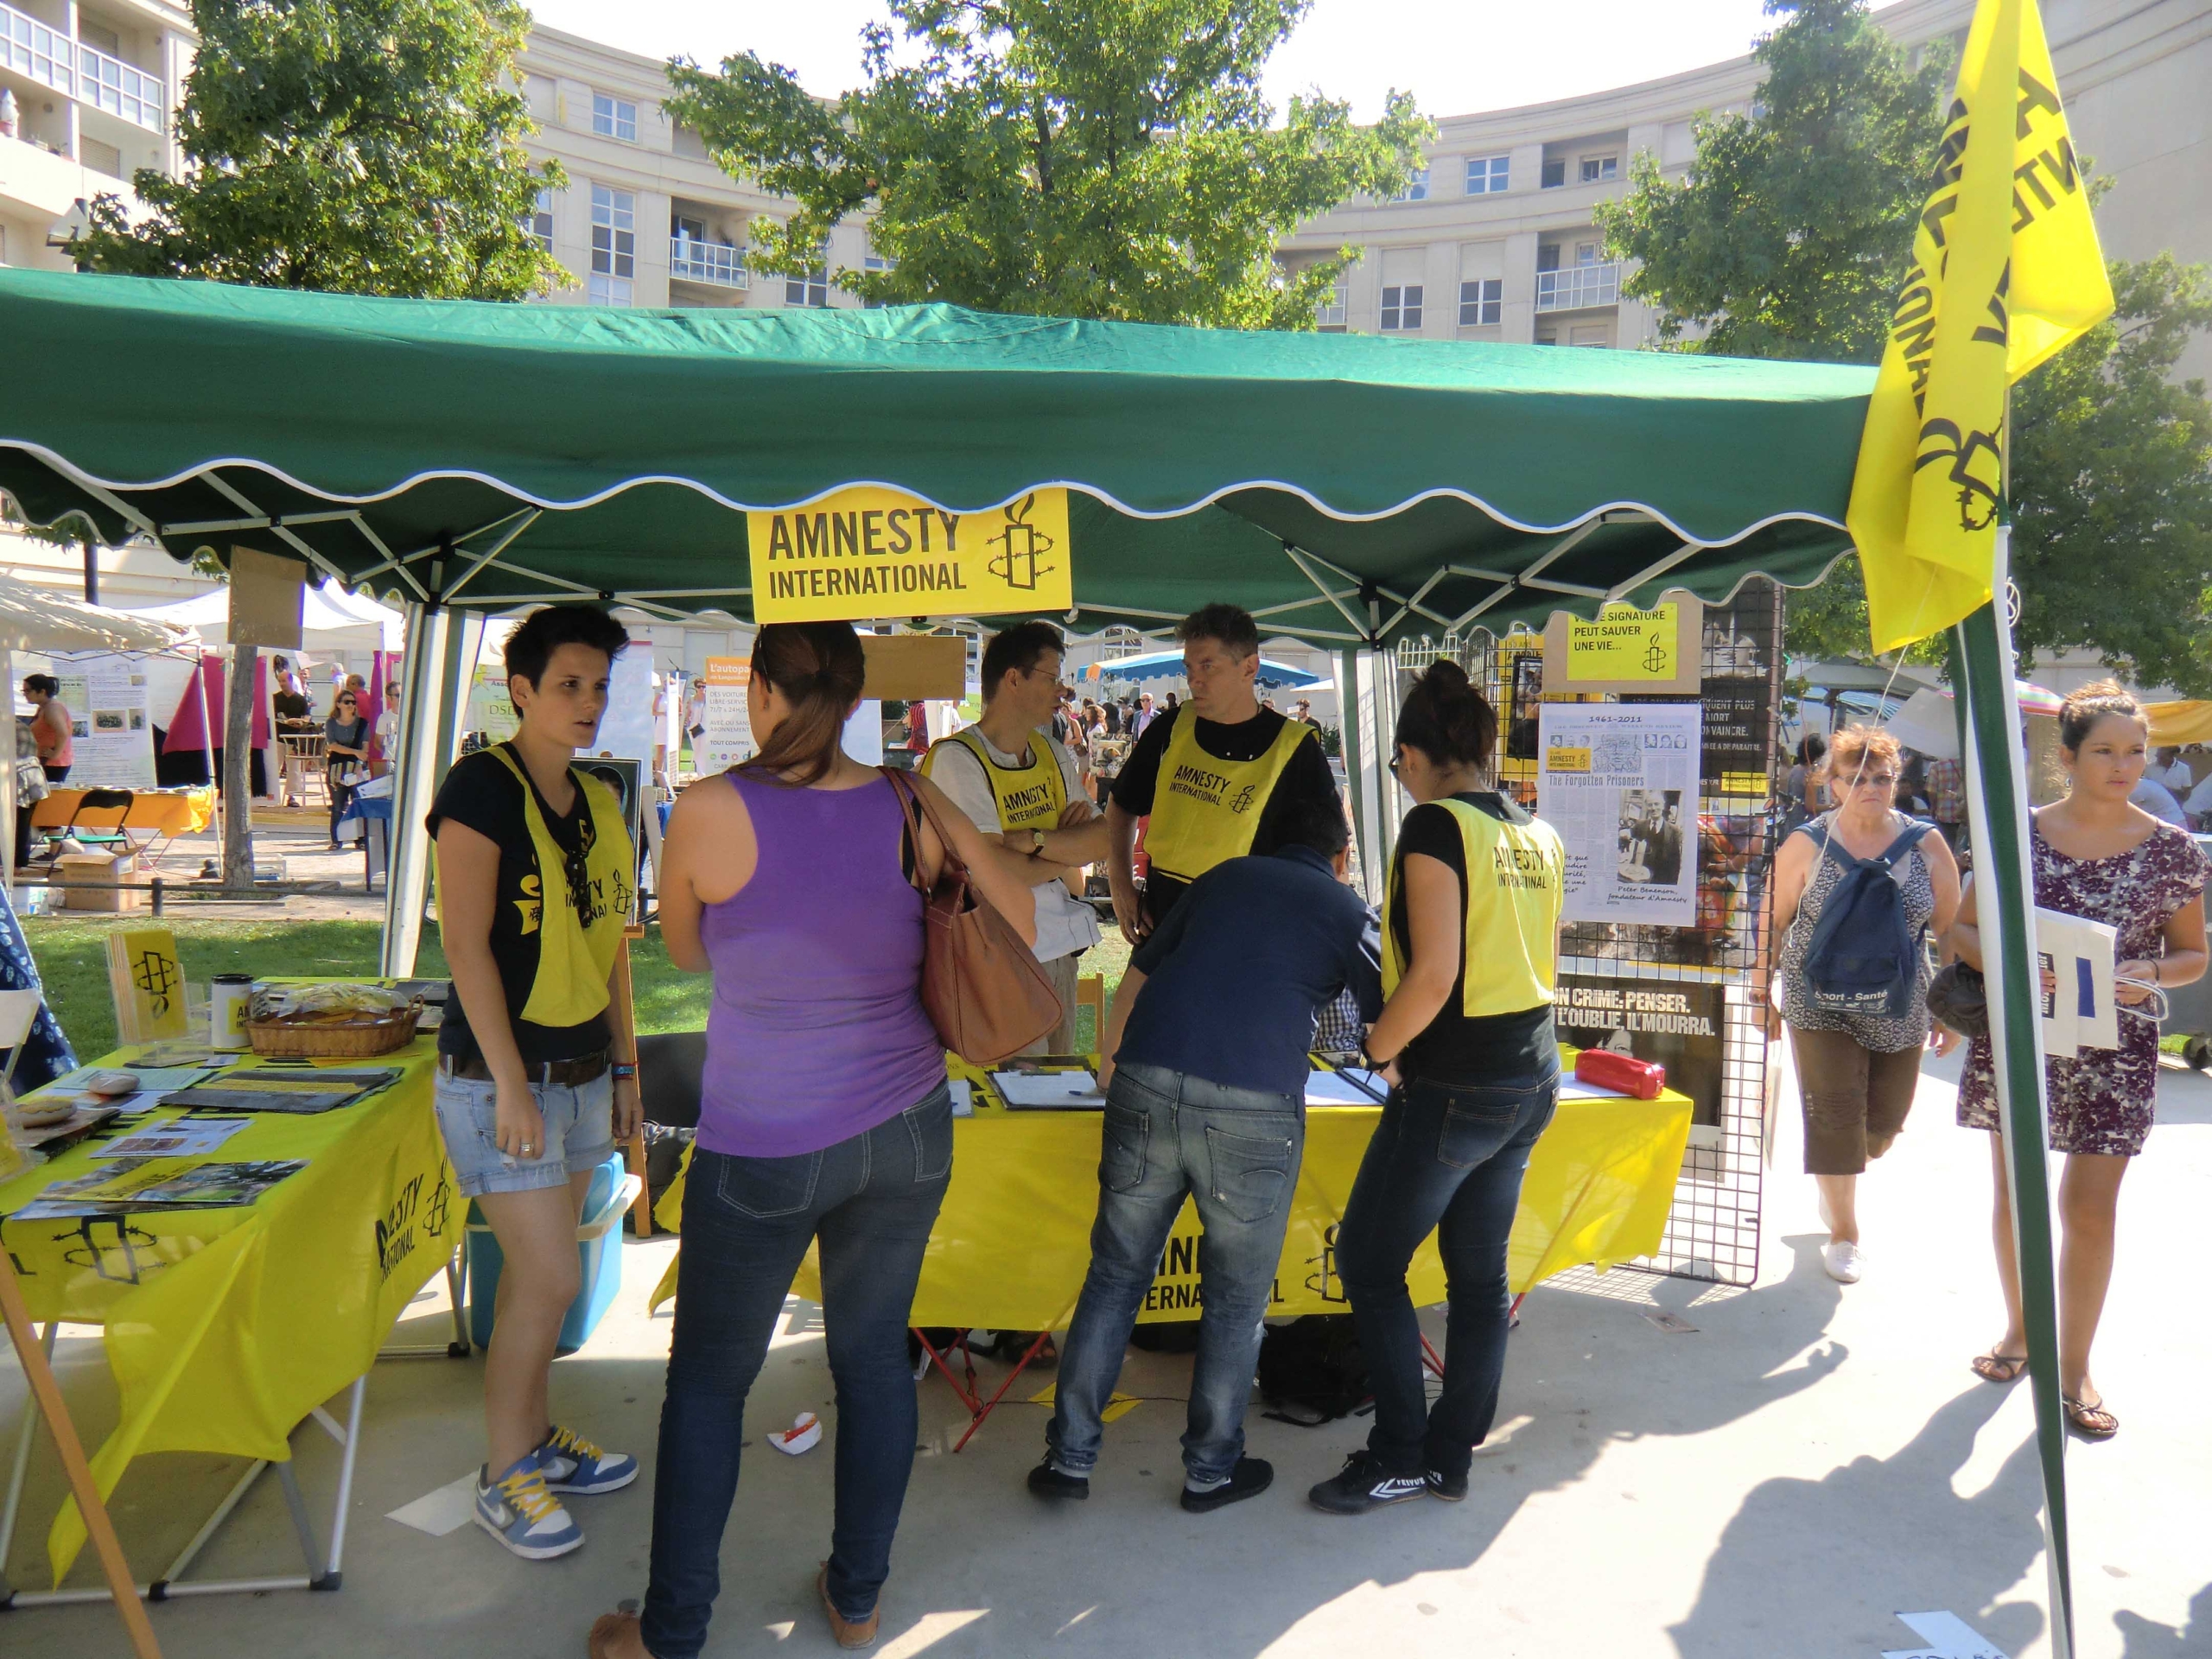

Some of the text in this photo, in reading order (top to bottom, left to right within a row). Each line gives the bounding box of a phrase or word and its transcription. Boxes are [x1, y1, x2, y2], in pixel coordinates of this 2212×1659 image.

[768, 507, 961, 561] AMNESTY
[769, 563, 967, 600] INTERNATIONAL
[1608, 611, 1665, 621] SIGNATURE
[1574, 626, 1641, 636] PEUT SAUVER
[1574, 641, 1622, 651] UNE VIE...
[1174, 765, 1231, 793] AMNESTY
[1549, 775, 1644, 788] The Forgotten Prisoners
[1169, 781, 1221, 806] INTERNATIONAL
[1624, 991, 1691, 1014] PENSER.
[1854, 988, 1888, 1001] Santé
[1558, 1007, 1625, 1032] L'OUBLIE,
[1643, 1014, 1716, 1036] MOURRA.
